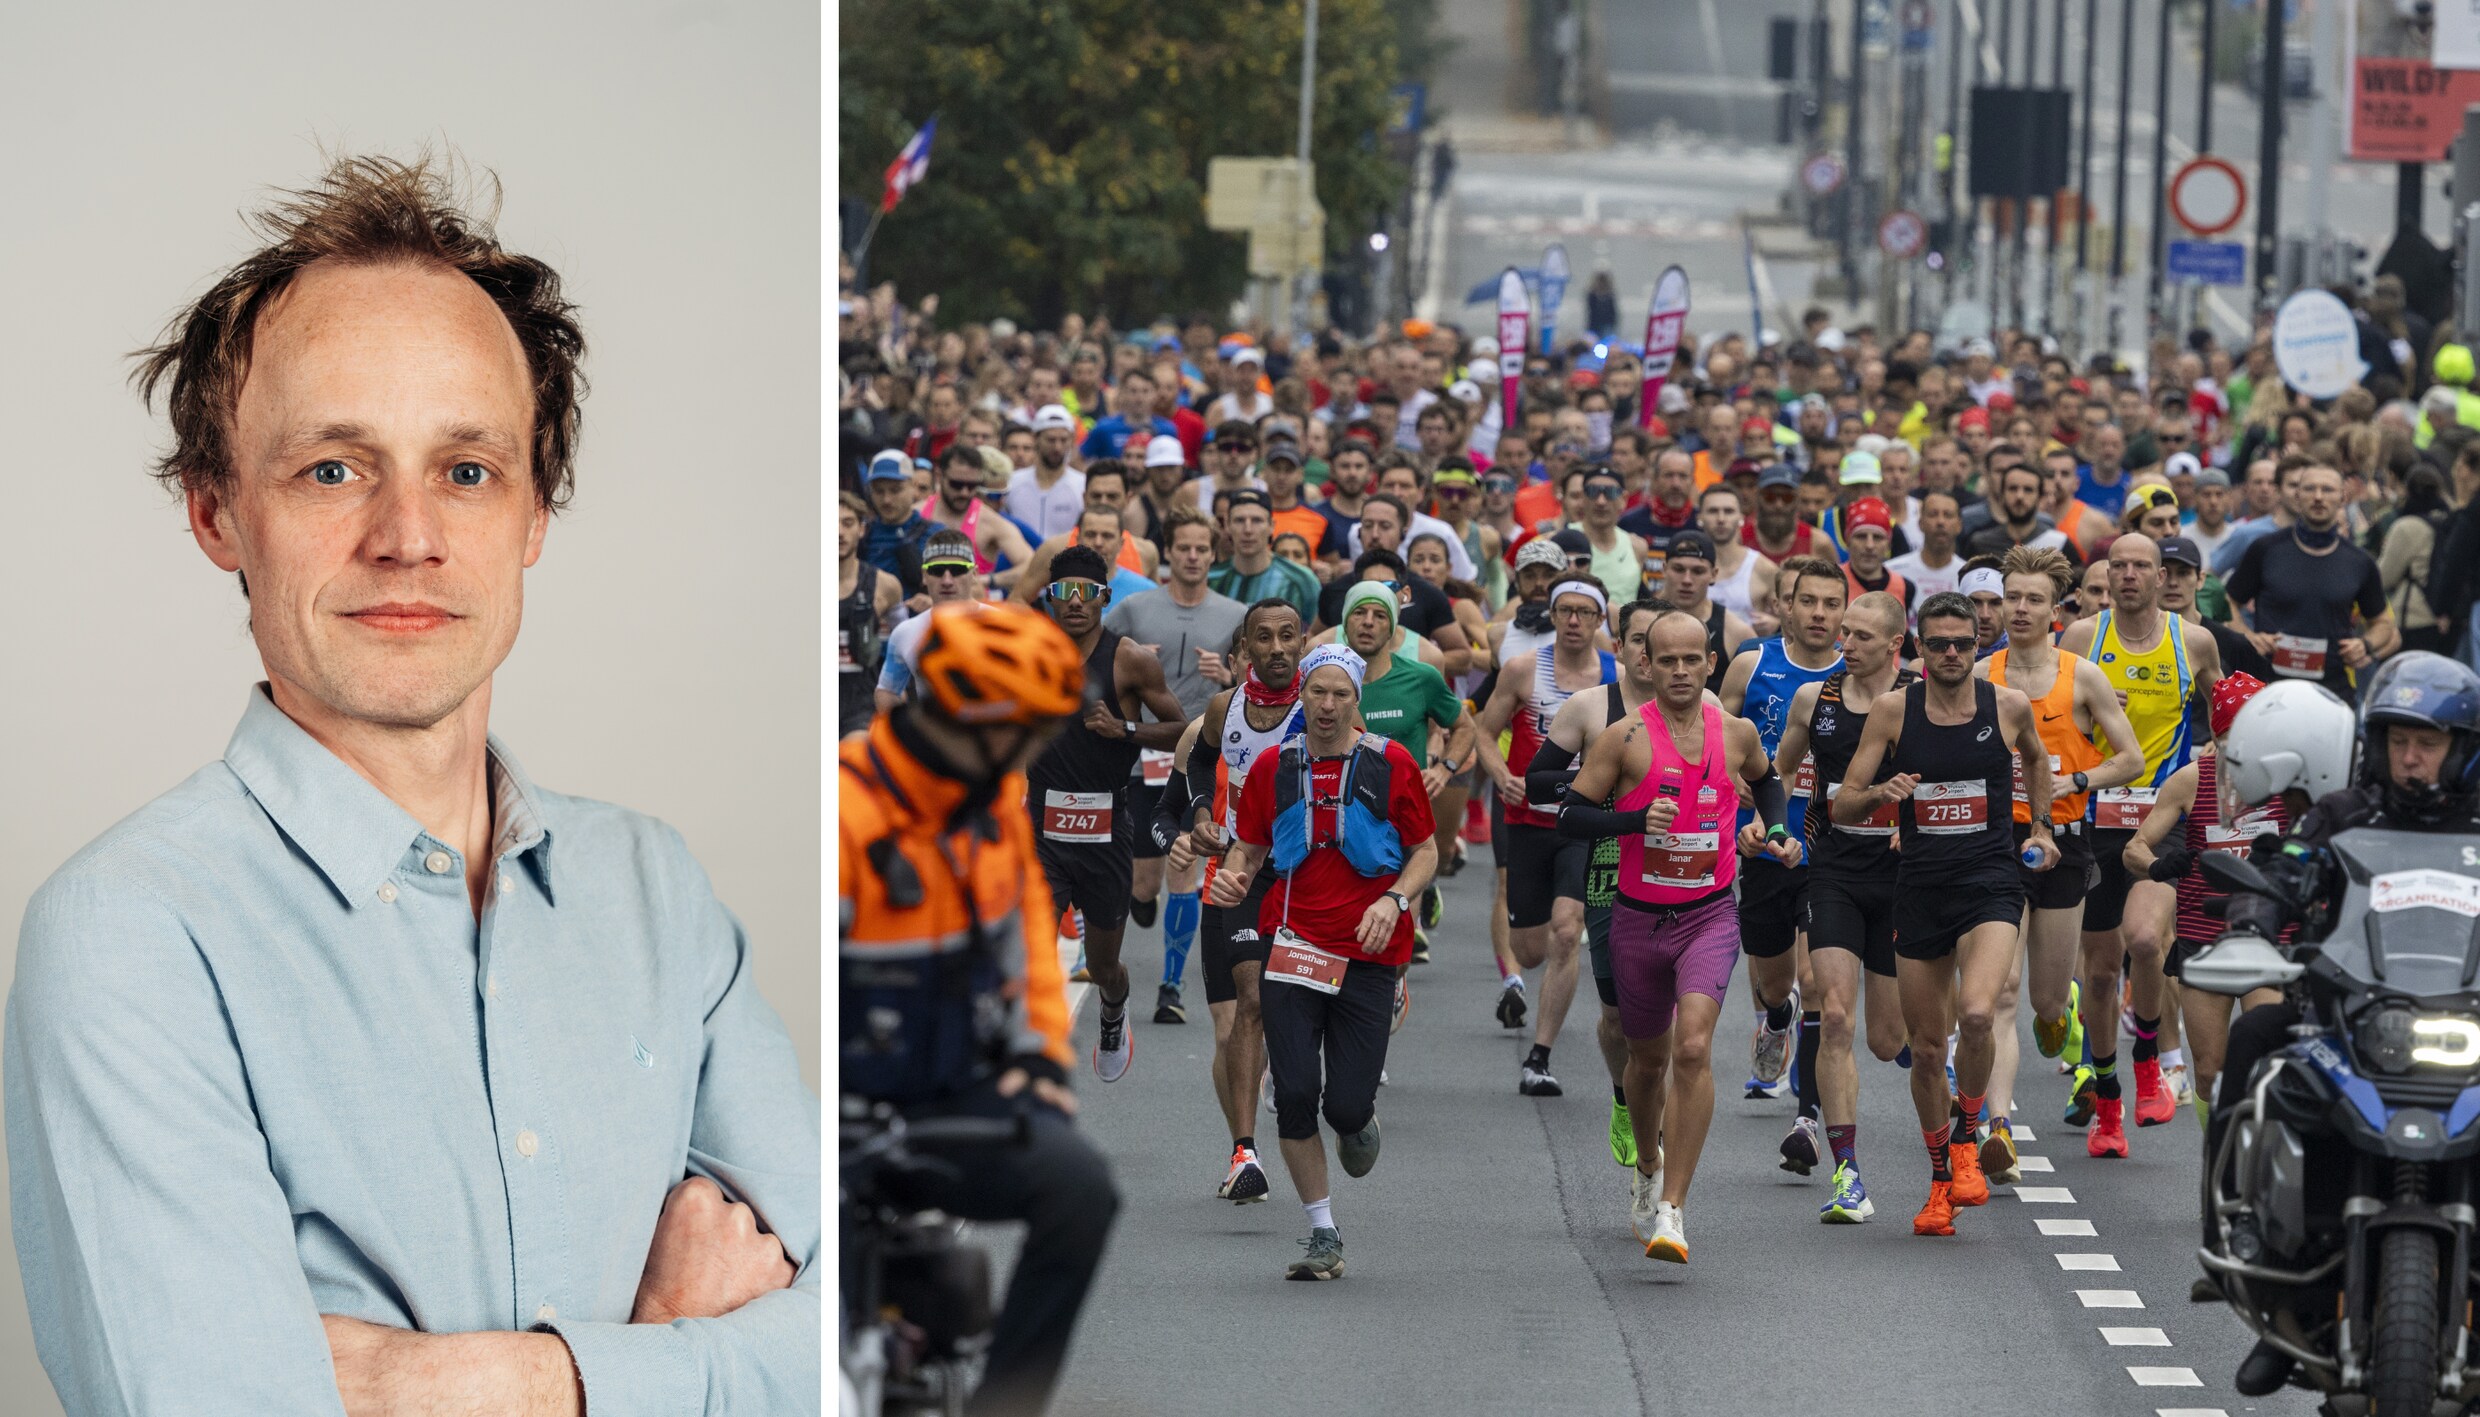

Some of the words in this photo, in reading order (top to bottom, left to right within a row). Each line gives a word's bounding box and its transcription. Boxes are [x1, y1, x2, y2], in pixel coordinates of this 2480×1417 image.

[1366, 709, 1404, 720] FINISHER
[2013, 769, 2023, 778] Ca
[1927, 803, 1972, 821] 2735
[2121, 804, 2139, 813] Nick
[1056, 813, 1098, 830] 2747
[2121, 816, 2139, 826] 1601
[1668, 854, 1693, 863] Janar
[1677, 867, 1684, 876] 2
[1287, 949, 1328, 967] Jonathan
[1296, 964, 1314, 976] 591
